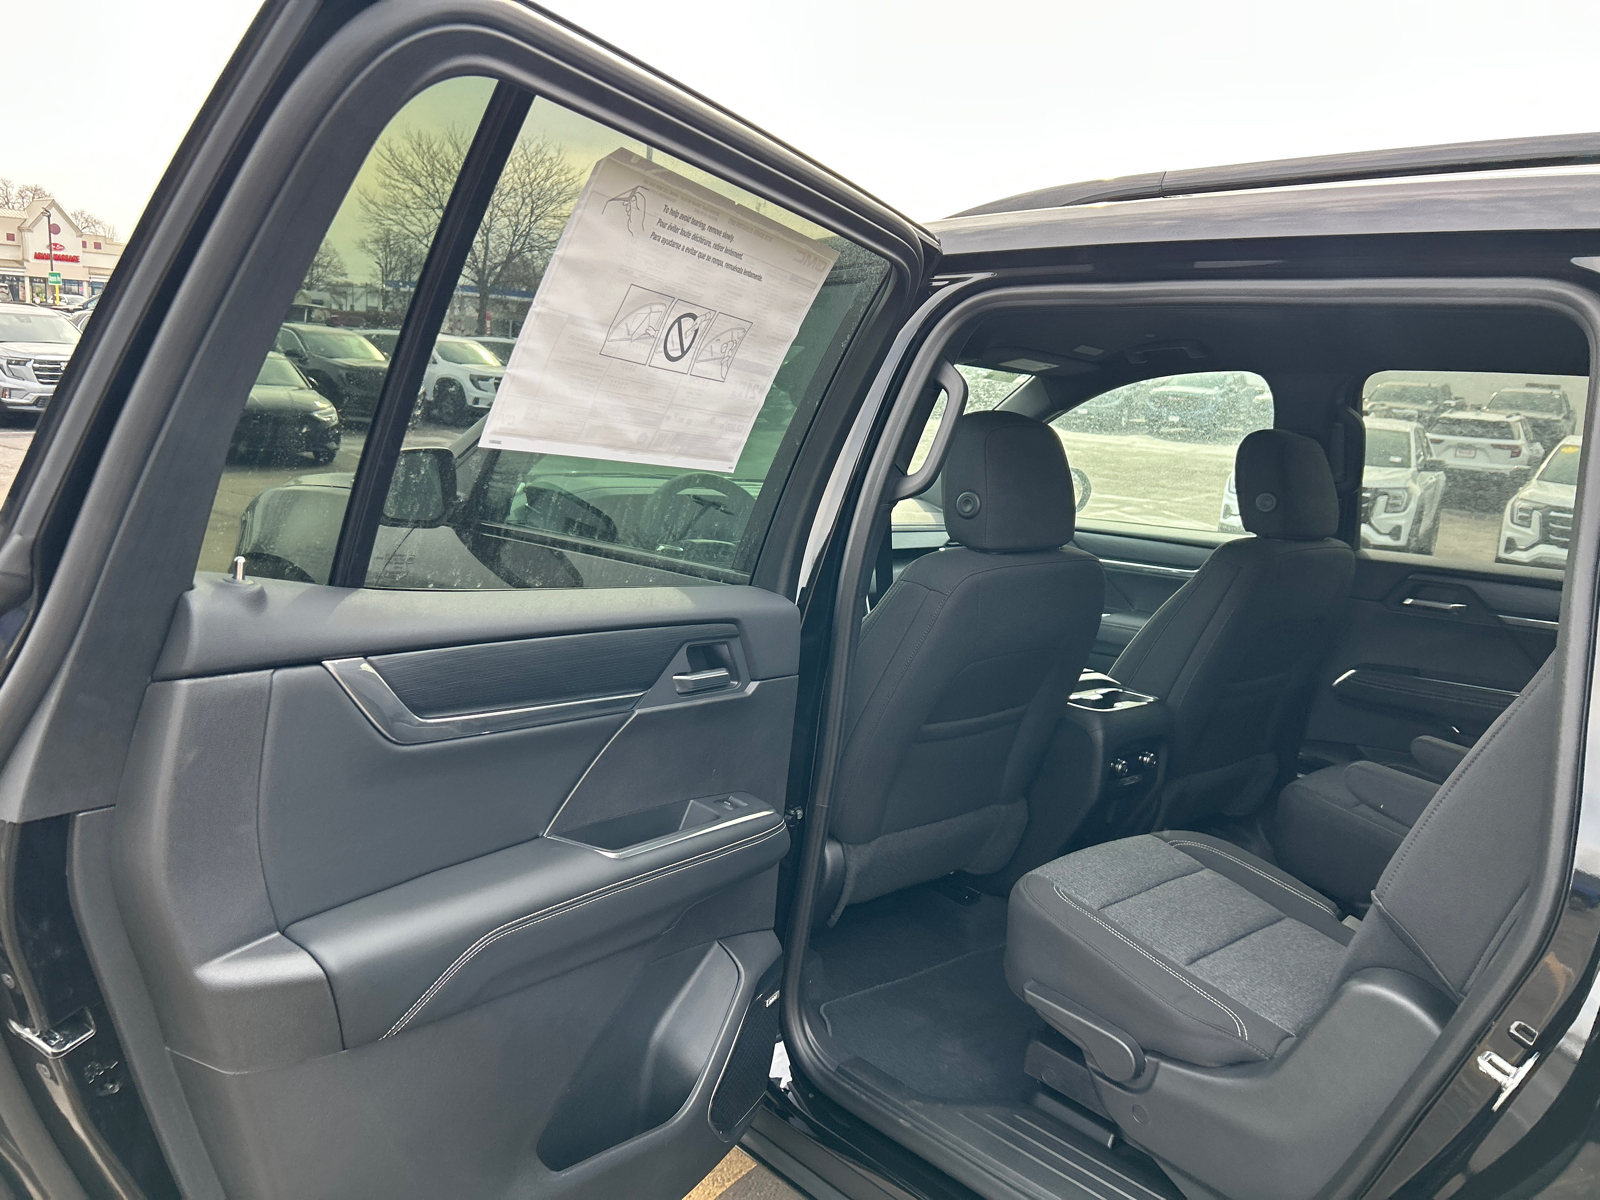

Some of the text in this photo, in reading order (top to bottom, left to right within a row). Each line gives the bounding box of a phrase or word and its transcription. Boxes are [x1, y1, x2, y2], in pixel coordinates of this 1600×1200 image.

[656, 218, 668, 229] Pour
[667, 222, 681, 234] éviter
[680, 228, 692, 239] toute
[691, 232, 712, 248] déchirure,
[712, 242, 725, 253] retirer
[663, 204, 670, 214] To
[669, 207, 680, 219] help
[679, 212, 692, 223] avoid
[691, 217, 707, 231] tearing,
[706, 225, 722, 237] remove
[650, 231, 661, 242] Para
[660, 237, 681, 250] ayudarse
[685, 246, 699, 257] evitar
[697, 251, 706, 260] que
[705, 254, 712, 262] se
[711, 257, 724, 268] rompa,
